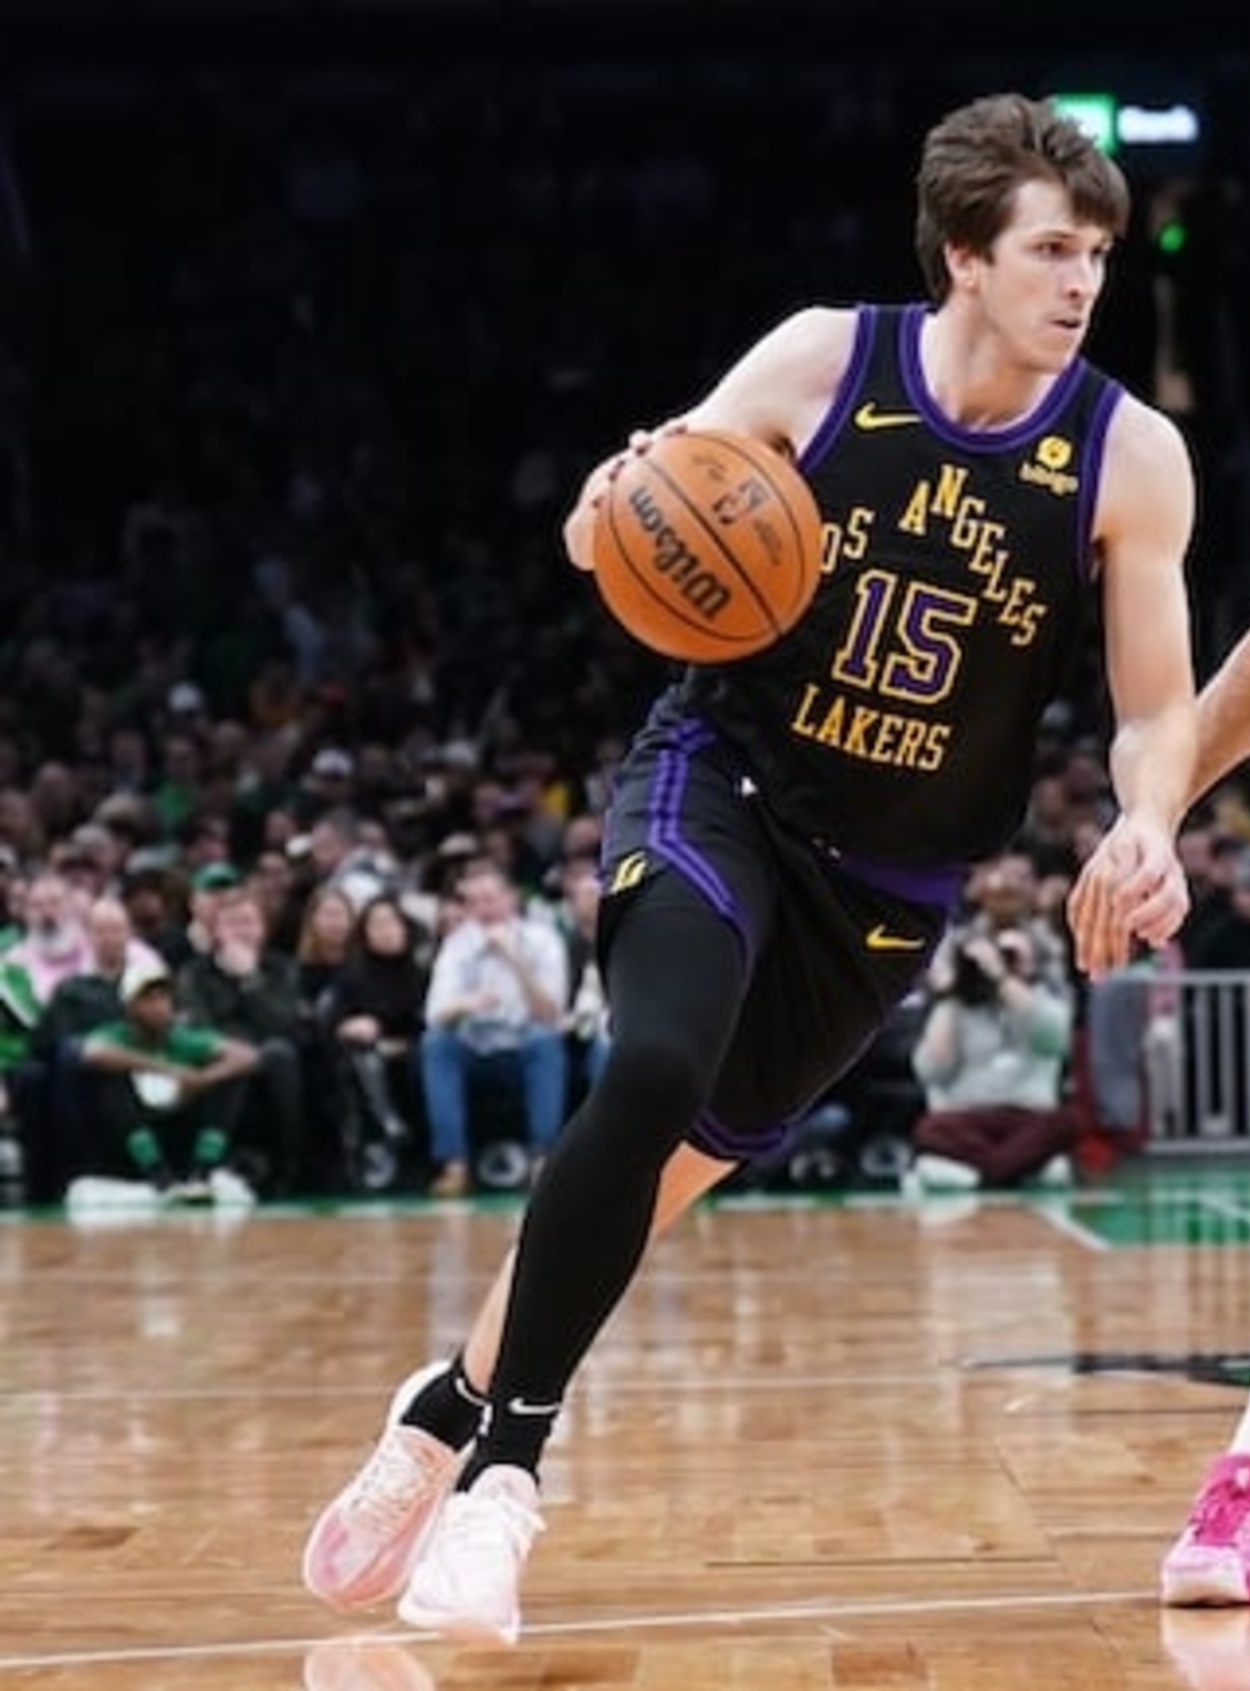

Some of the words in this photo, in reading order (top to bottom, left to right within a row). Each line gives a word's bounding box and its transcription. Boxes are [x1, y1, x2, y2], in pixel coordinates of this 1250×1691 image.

[629, 485, 731, 621] Wilson
[820, 507, 875, 573] OS
[900, 464, 1047, 647] ANGELES
[831, 568, 978, 704] 15
[791, 683, 952, 771] LAKERS
